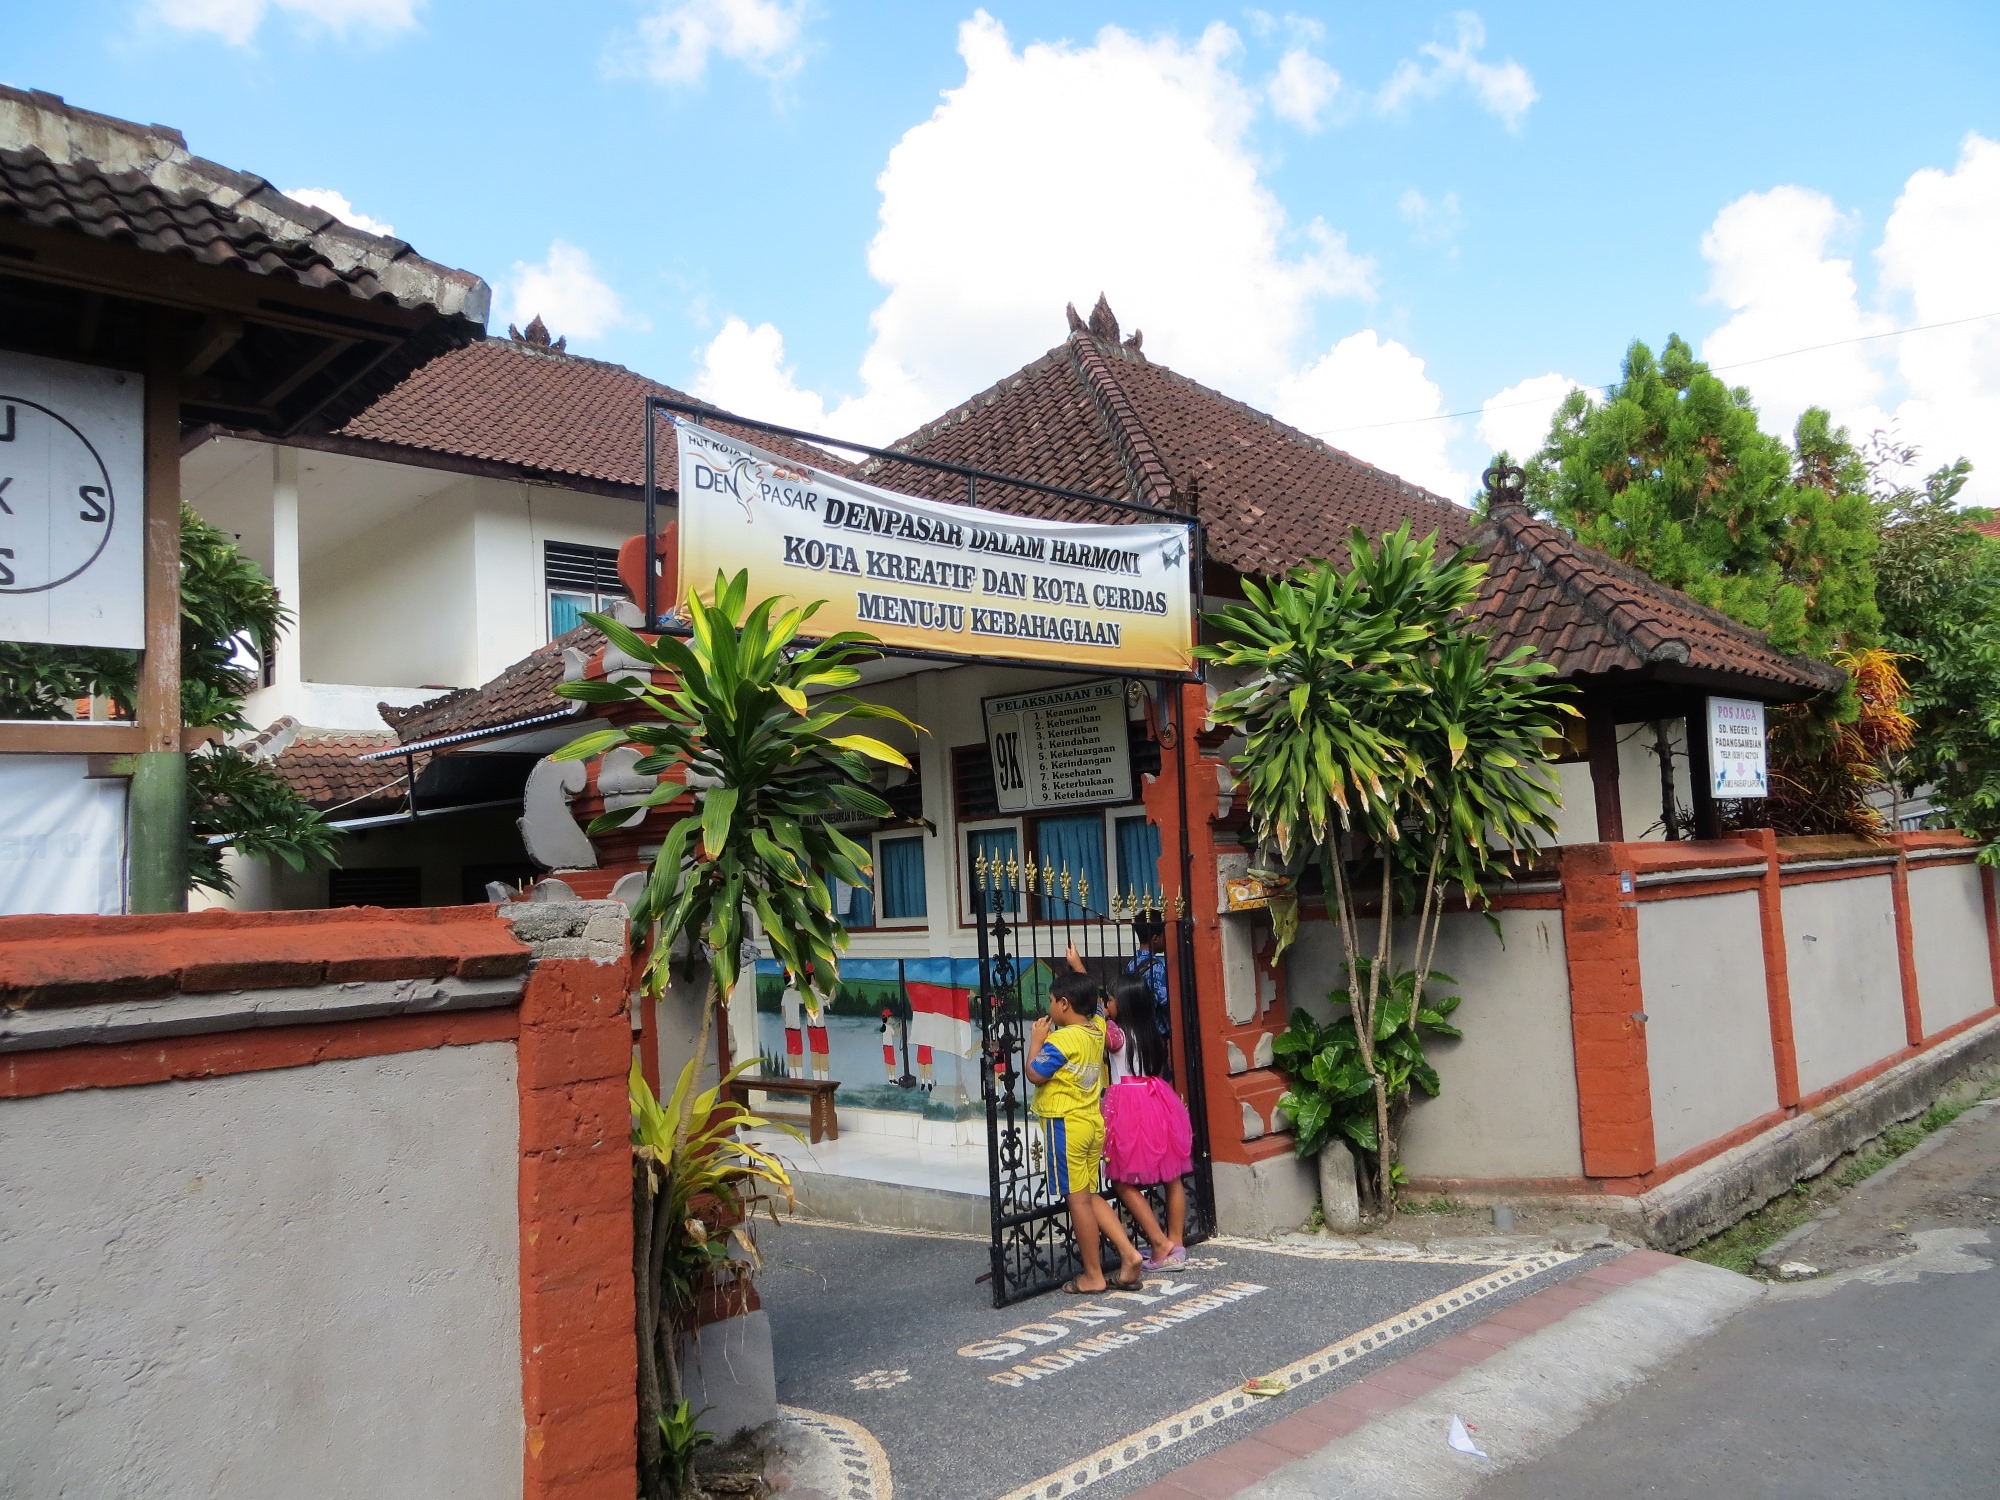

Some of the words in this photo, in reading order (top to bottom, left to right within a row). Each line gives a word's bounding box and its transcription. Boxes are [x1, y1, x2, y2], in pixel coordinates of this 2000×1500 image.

[688, 435, 710, 448] HUT
[711, 442, 742, 457] KOTA
[79, 485, 106, 523] S
[760, 484, 818, 512] PASAR
[823, 498, 964, 547] DENPASAR
[968, 528, 1045, 560] DALAM
[1050, 539, 1141, 575] HARMONI
[784, 535, 860, 573] KOTA
[866, 550, 976, 589] KREATIF
[982, 567, 1027, 597] DAN
[1032, 575, 1090, 605] KOTA
[1093, 583, 1168, 614] CERDAS
[857, 592, 964, 632] MENUJU
[970, 607, 1121, 646] KEBAHAGIAAN
[996, 689, 1091, 712] PELAKSANAAN
[1094, 685, 1114, 696] 9K
[1034, 712, 1043, 720] 1.
[1045, 704, 1097, 719] Keamanan
[1718, 706, 1733, 718] POS
[1734, 707, 1756, 720] JAGA
[1035, 722, 1044, 730] 2.
[1047, 714, 1101, 729] Kebersihan
[1719, 724, 1729, 734] SD.
[1730, 725, 1750, 735] NEGERI
[1751, 726, 1758, 736] 12
[1036, 732, 1045, 740] 3.
[1048, 726, 1099, 739] Ketertiban
[1037, 742, 1046, 751] 4.
[1049, 736, 1100, 749] Keindahan
[1715, 737, 1762, 748] PADANGSAMBIAN
[996, 731, 1024, 791] 9K
[1038, 752, 1047, 761] 5.
[1050, 745, 1115, 759] Kekeluargaan
[1039, 762, 1048, 771] 6.
[1051, 756, 1112, 770] Kerindangan
[1040, 772, 1049, 781] 7.
[1052, 767, 1102, 780] Kesehatan
[1041, 782, 1050, 791] 8.
[1053, 777, 1114, 790] Keterbukaan
[1042, 792, 1051, 801] 9.
[1053, 787, 1114, 800] Keteladanan
[957, 1301, 1127, 1361] SDN
[1104, 1279, 1200, 1305] 12
[987, 1331, 1141, 1387] PADANG
[1122, 1281, 1270, 1334] SAMBIAN
